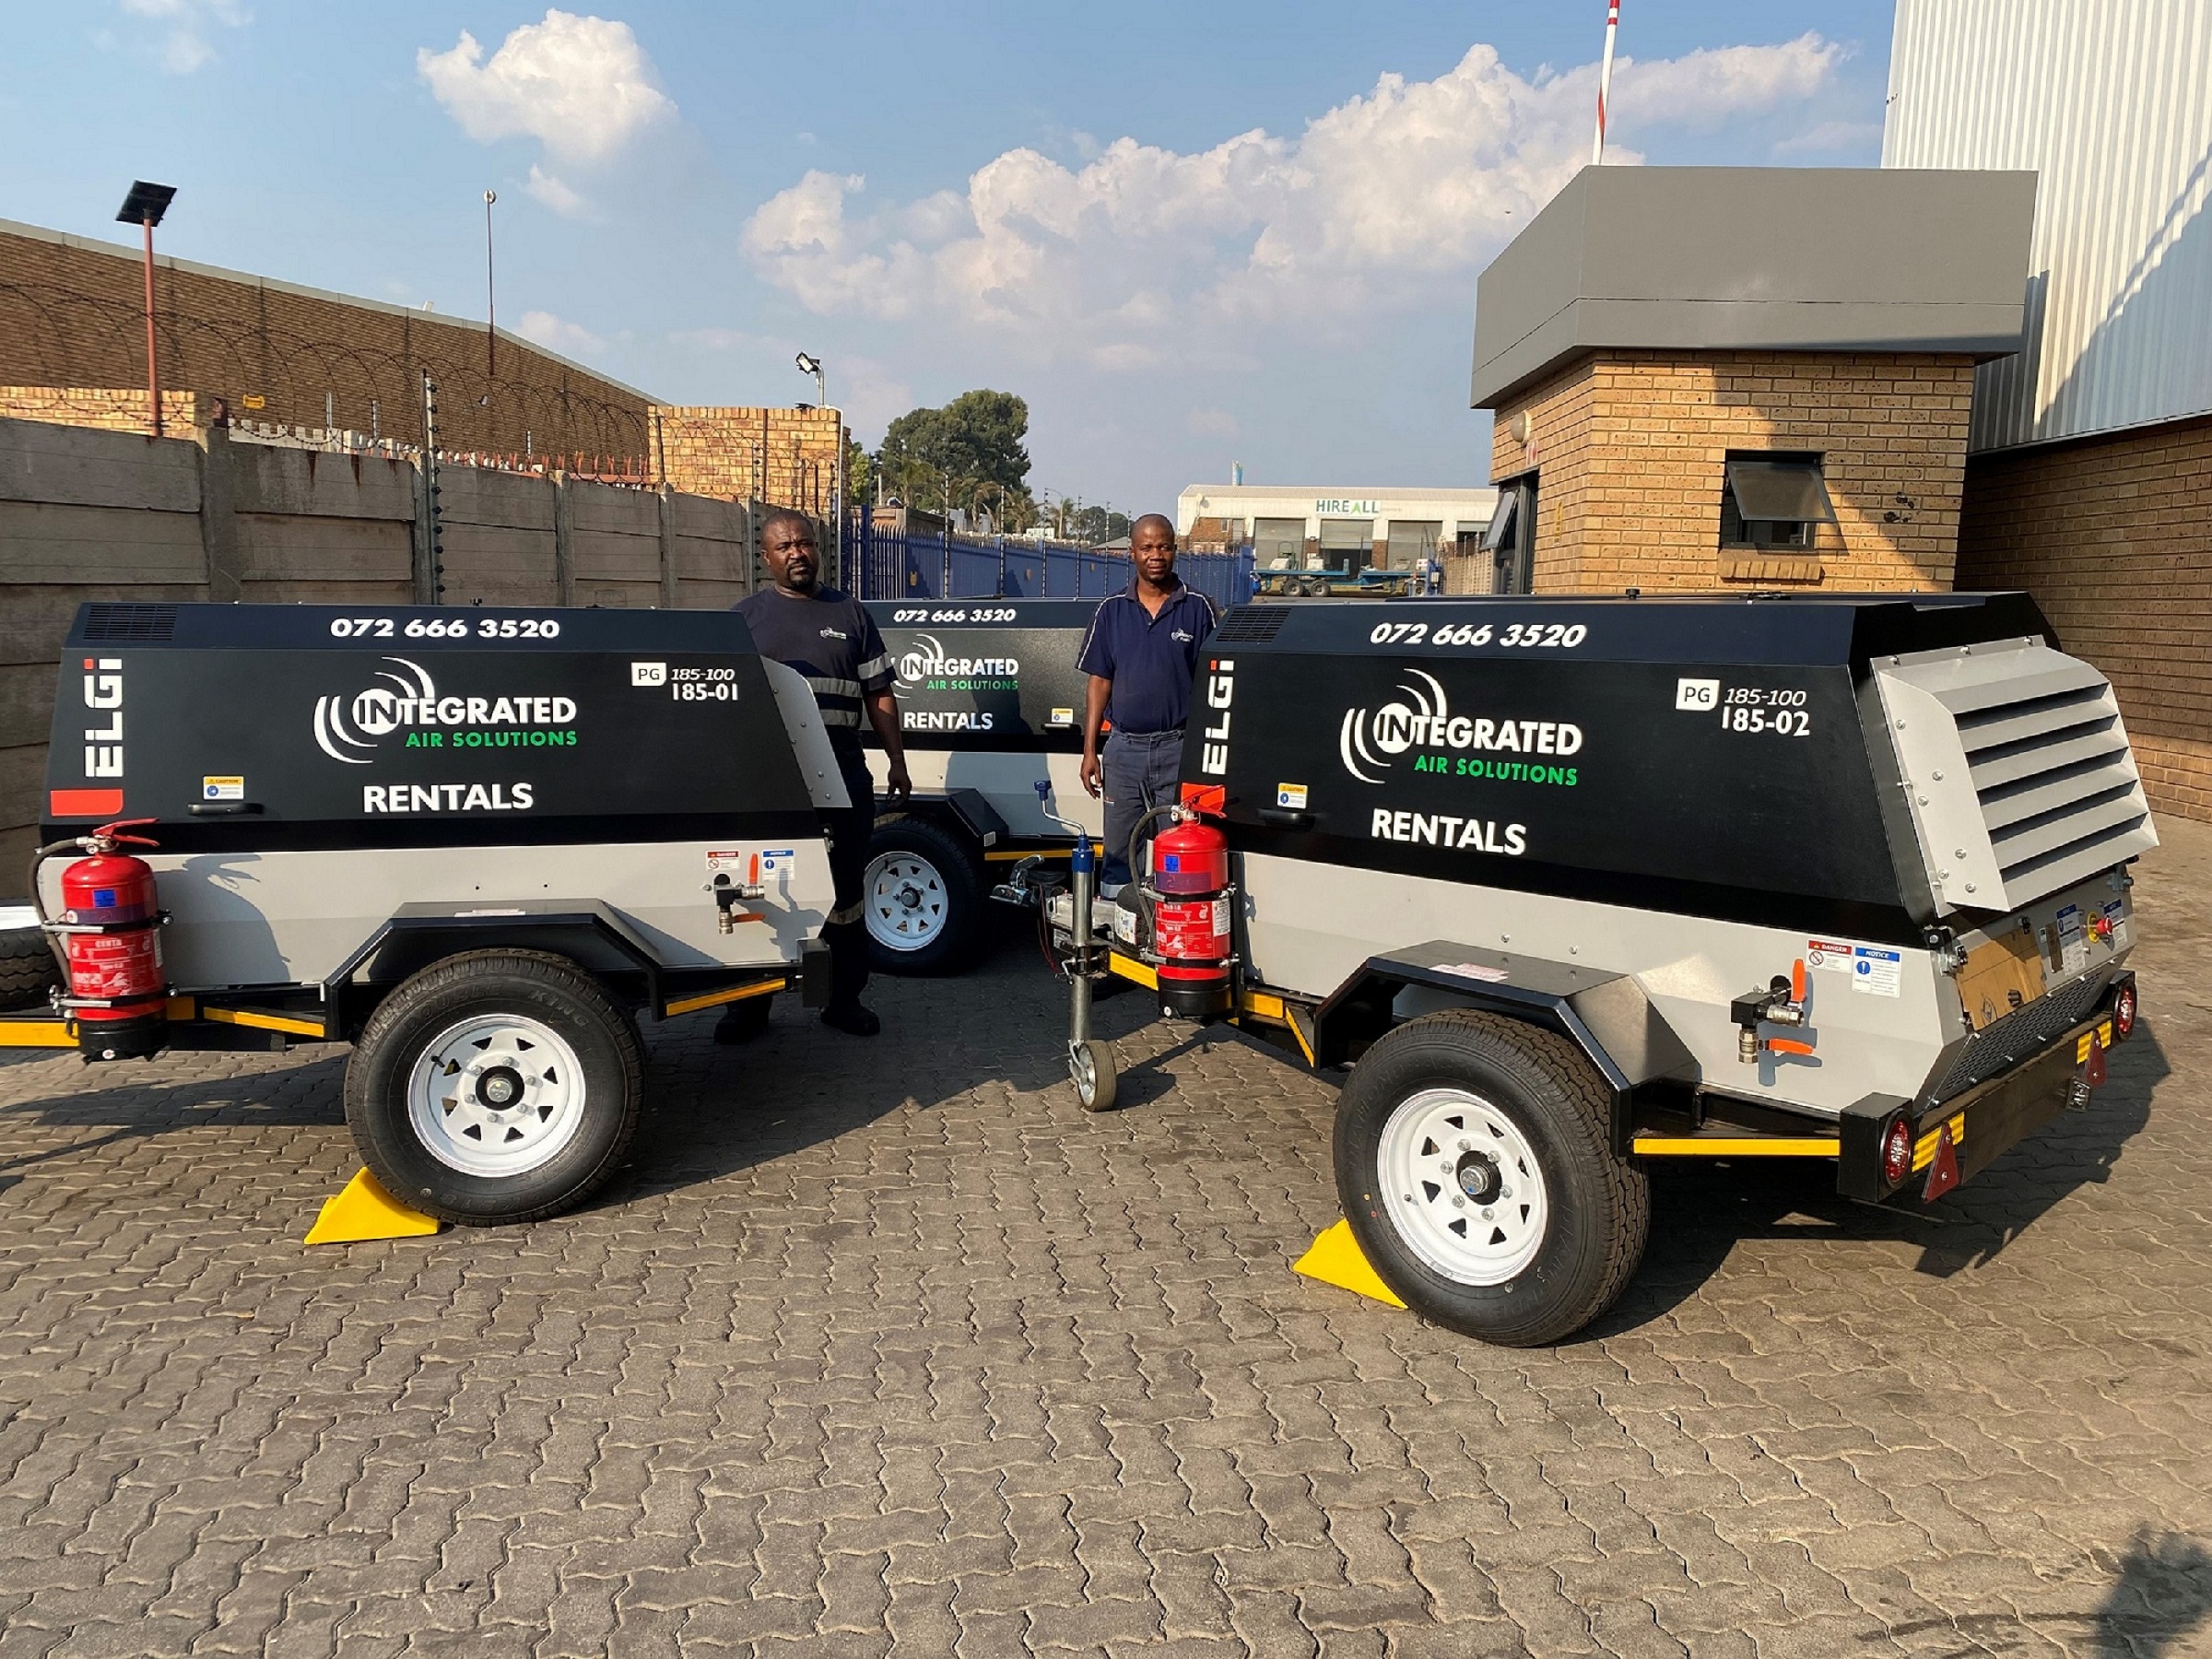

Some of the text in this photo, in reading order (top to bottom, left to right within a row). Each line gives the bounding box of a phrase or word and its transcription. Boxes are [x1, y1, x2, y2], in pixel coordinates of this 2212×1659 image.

[893, 608, 1017, 622] 072 666 3520
[330, 618, 560, 639] 072 666 3520
[1370, 622, 1587, 647] 072 666 3520
[638, 668, 735, 680] PG 185-100
[901, 658, 1019, 676] INTEGRATED
[672, 683, 738, 700] 185-01
[926, 679, 1018, 690] AIR SOLUTIONS
[1684, 687, 1806, 706] PG 185-100
[354, 696, 577, 725] INTEGRATED
[903, 712, 994, 730] RENTALS
[1722, 706, 1810, 736] 185-02
[405, 730, 578, 747] AIR SOLUTIONS
[1376, 712, 1583, 756] INTEGRATED
[1414, 755, 1578, 786] AIR SOLUTIONS
[363, 782, 534, 813] RENTALS
[1371, 807, 1526, 855] RENTALS
[1821, 944, 1847, 953] DANGER
[1865, 950, 1889, 959] NOTICE
